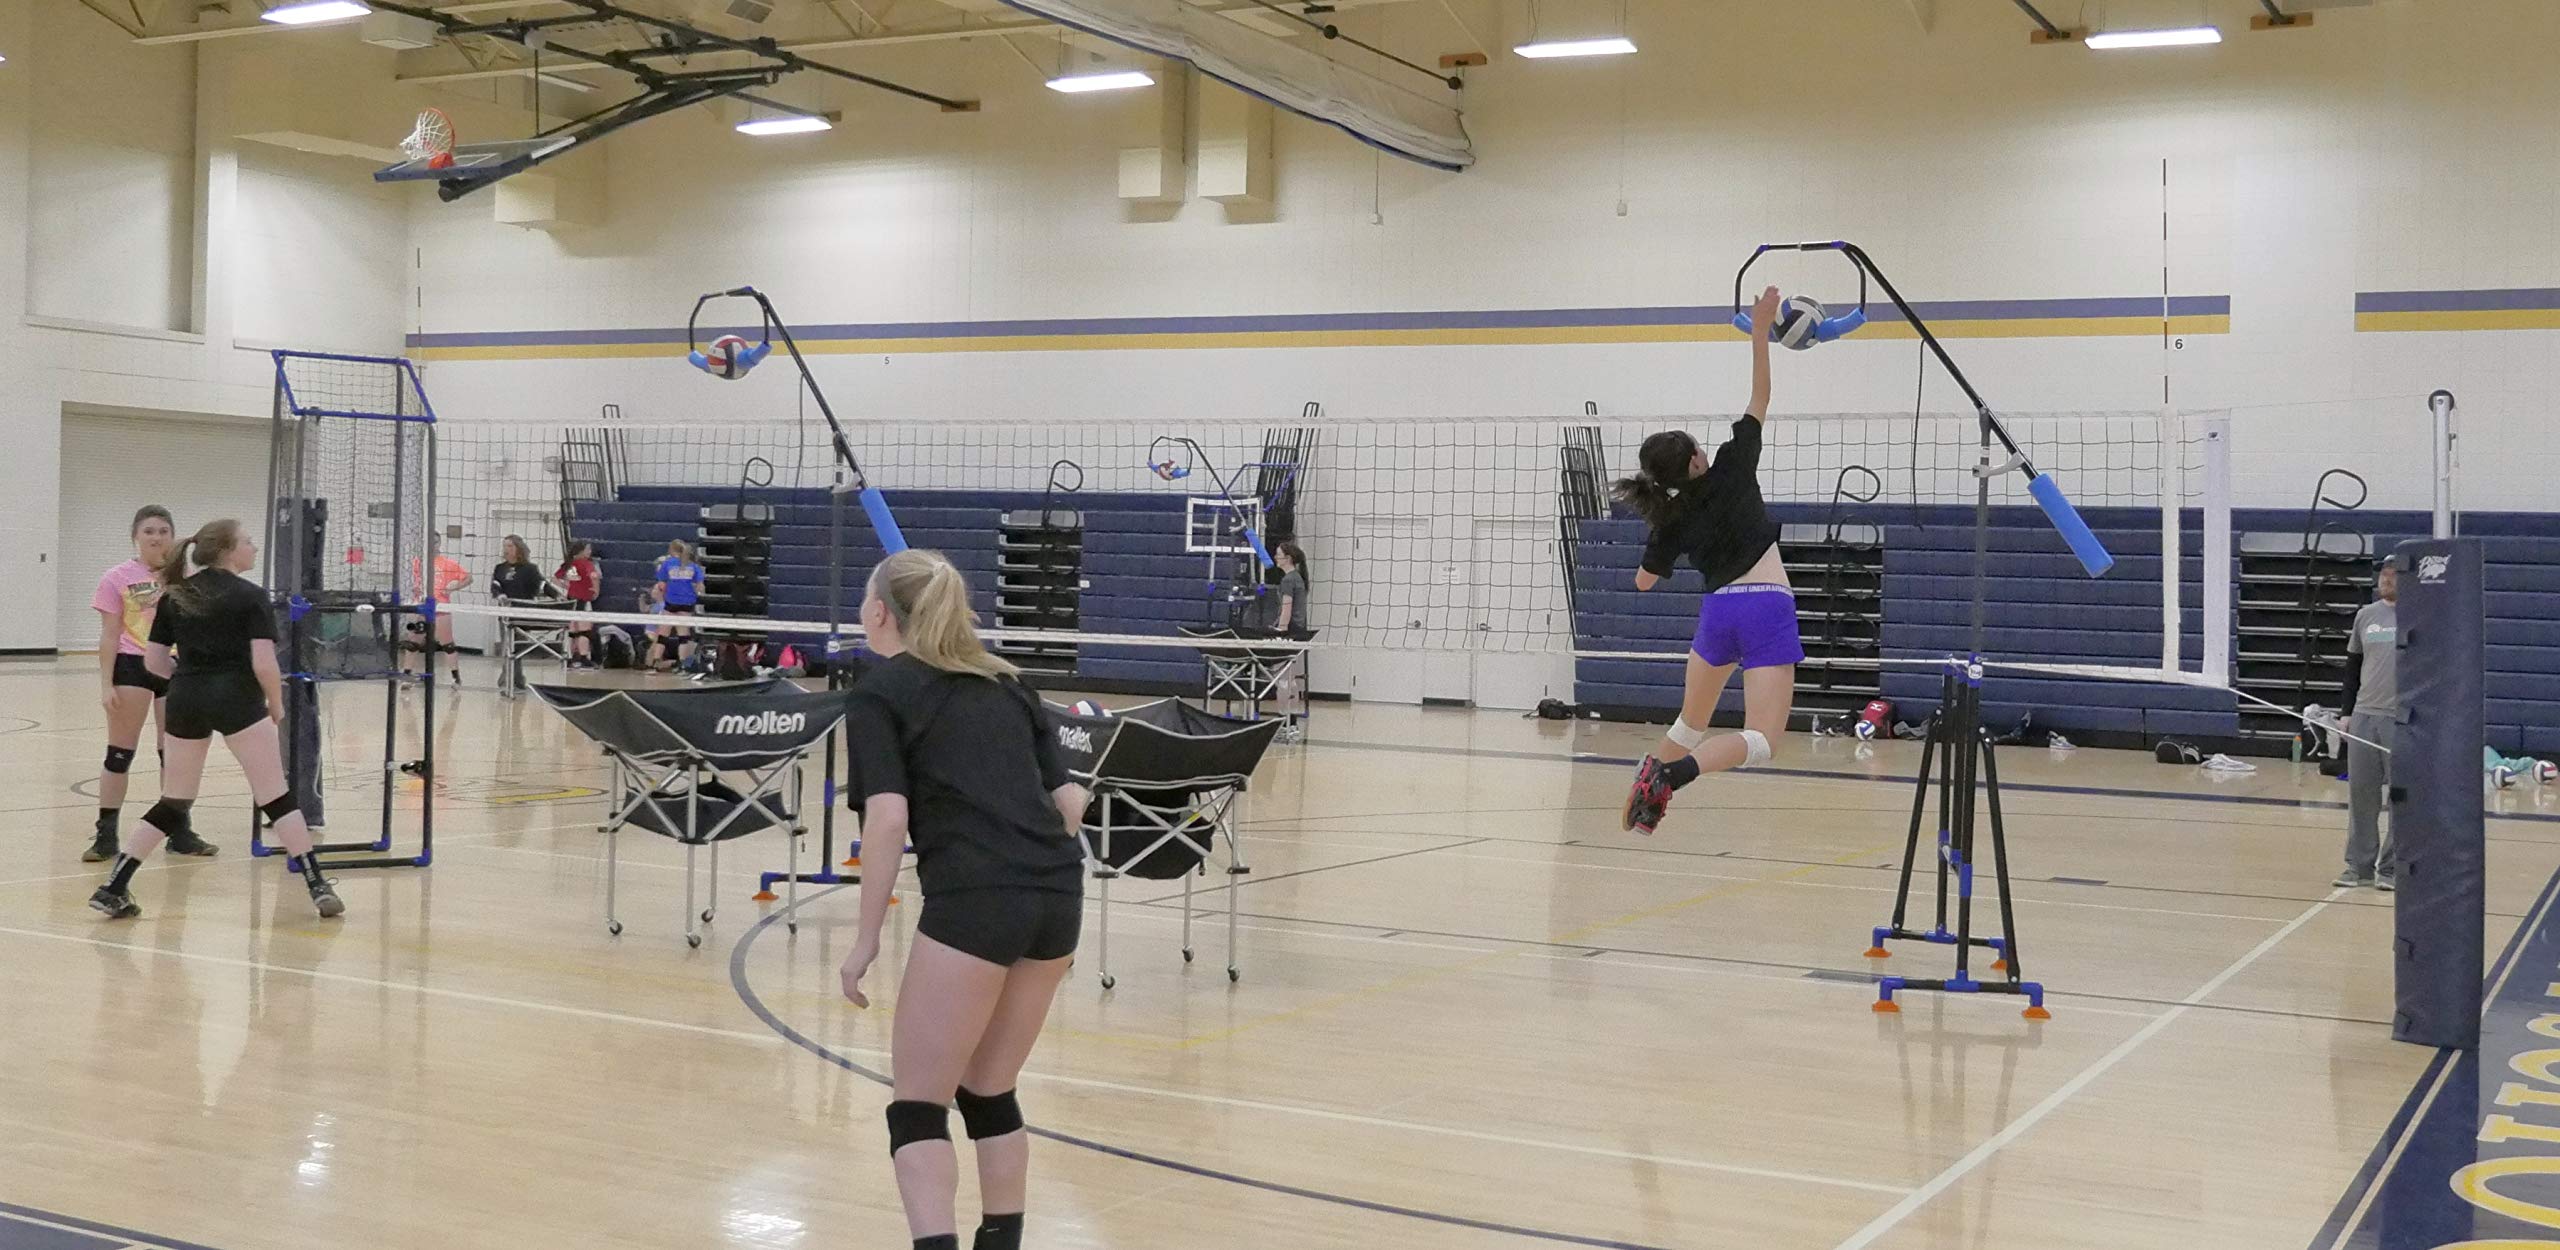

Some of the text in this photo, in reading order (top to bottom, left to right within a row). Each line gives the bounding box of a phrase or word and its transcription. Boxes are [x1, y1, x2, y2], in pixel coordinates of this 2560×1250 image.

[2175, 338, 2183, 350] 6
[884, 356, 890, 365] 5
[715, 710, 806, 735] molten
